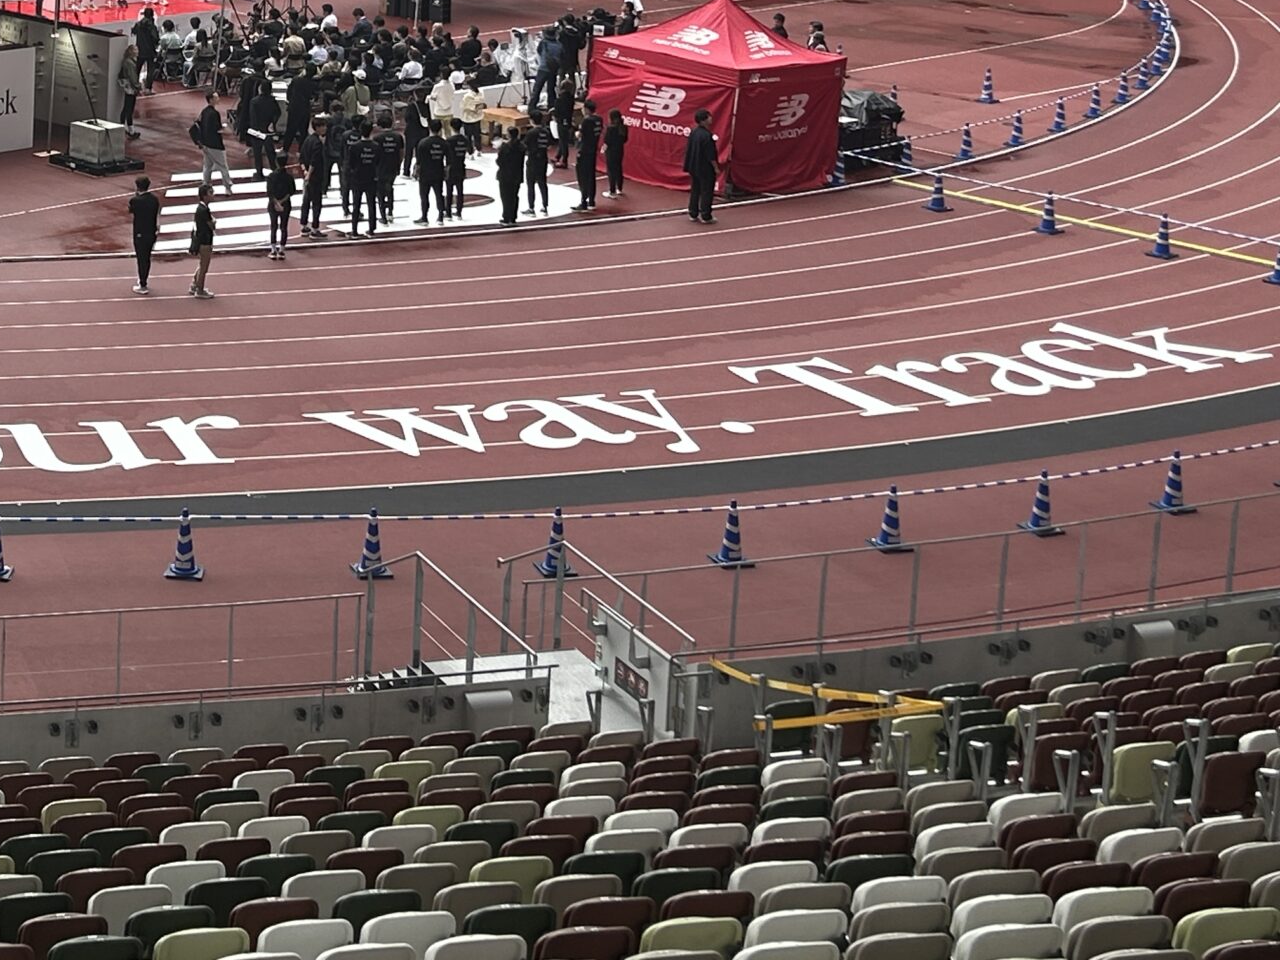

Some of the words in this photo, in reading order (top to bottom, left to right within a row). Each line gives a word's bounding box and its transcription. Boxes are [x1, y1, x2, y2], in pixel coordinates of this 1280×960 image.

[629, 82, 687, 118] NB
[642, 117, 692, 137] balance
[301, 389, 756, 457] way.
[727, 322, 1274, 418] Track
